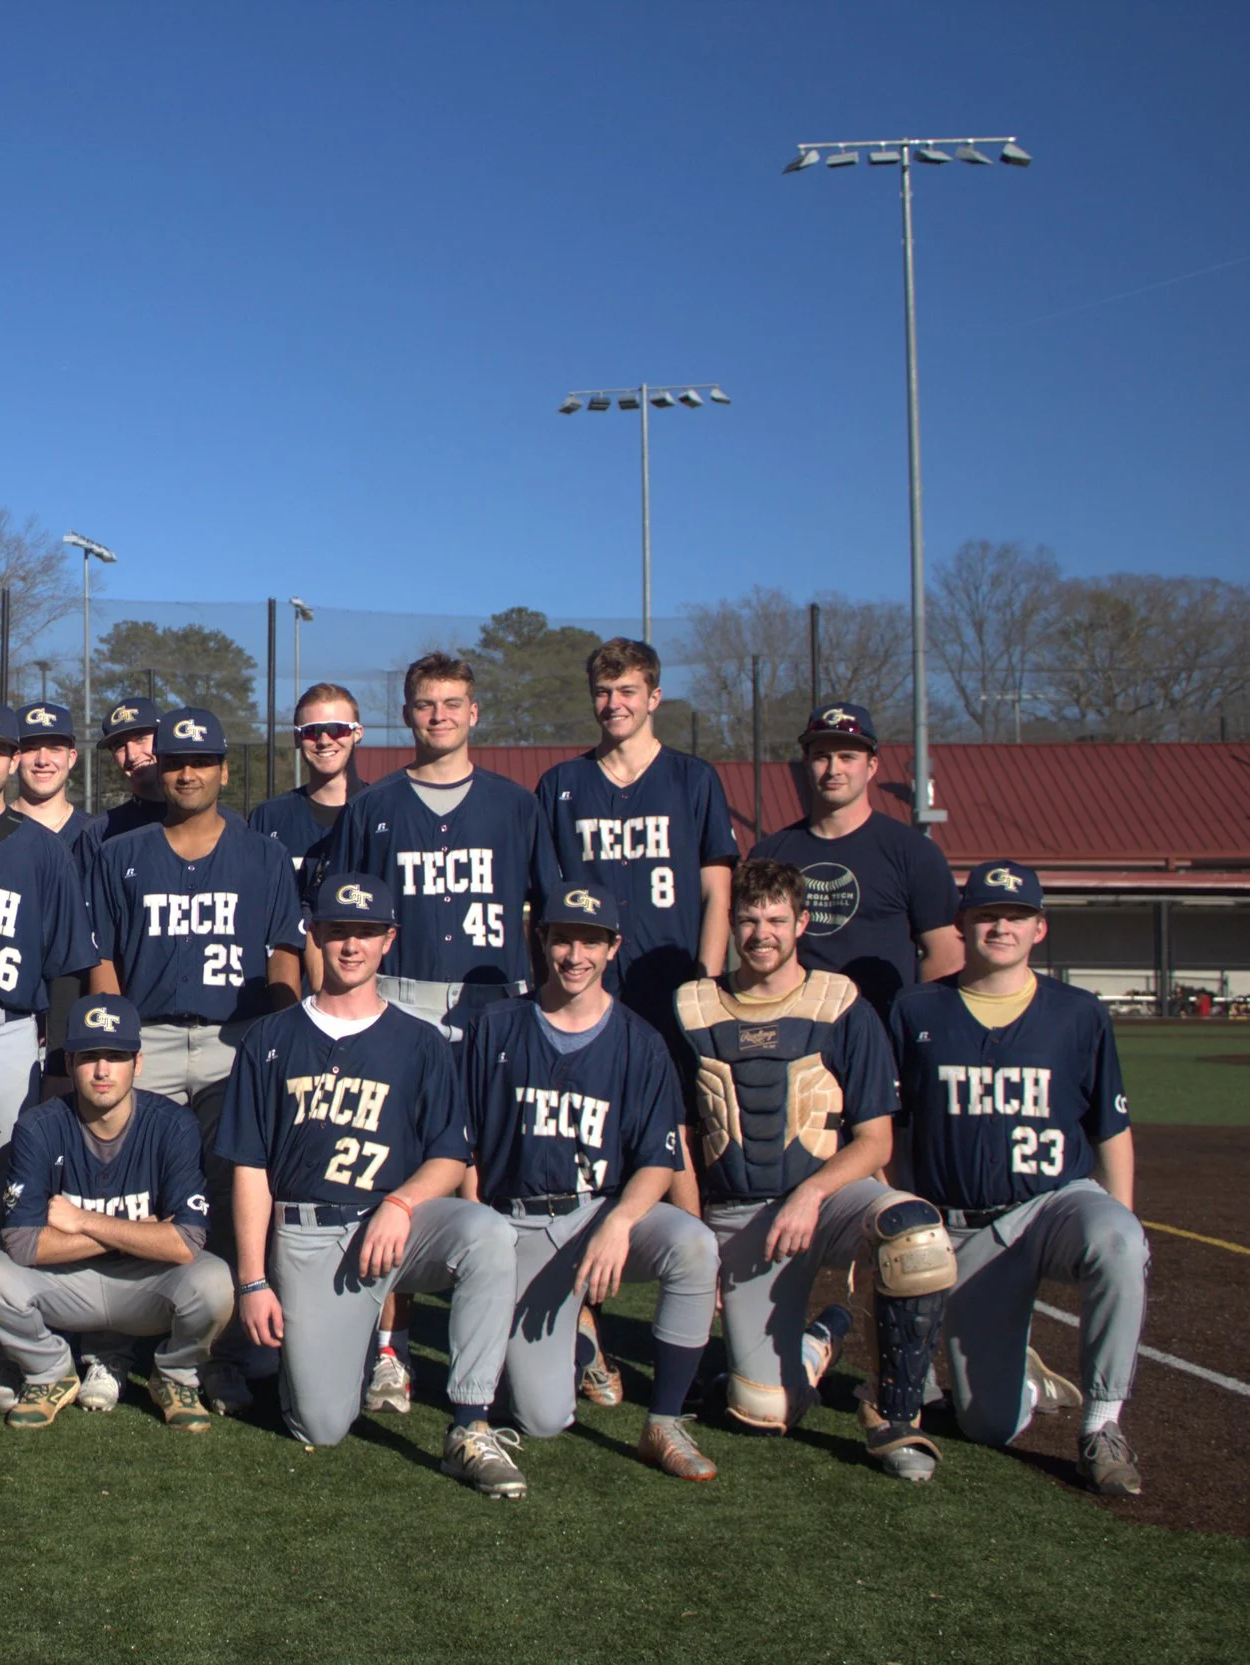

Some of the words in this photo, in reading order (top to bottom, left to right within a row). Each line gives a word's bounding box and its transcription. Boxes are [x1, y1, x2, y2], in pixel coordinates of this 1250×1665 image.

[577, 816, 670, 860] TECH
[397, 849, 493, 895] TECH
[651, 867, 674, 907] 8
[144, 893, 238, 936] TECH
[463, 903, 503, 947] 45
[203, 944, 244, 986] 25
[287, 1074, 389, 1131] TECH
[939, 1066, 1051, 1117] TECH
[516, 1088, 609, 1148] TECH
[325, 1138, 389, 1190] 27
[1012, 1127, 1064, 1176] 23
